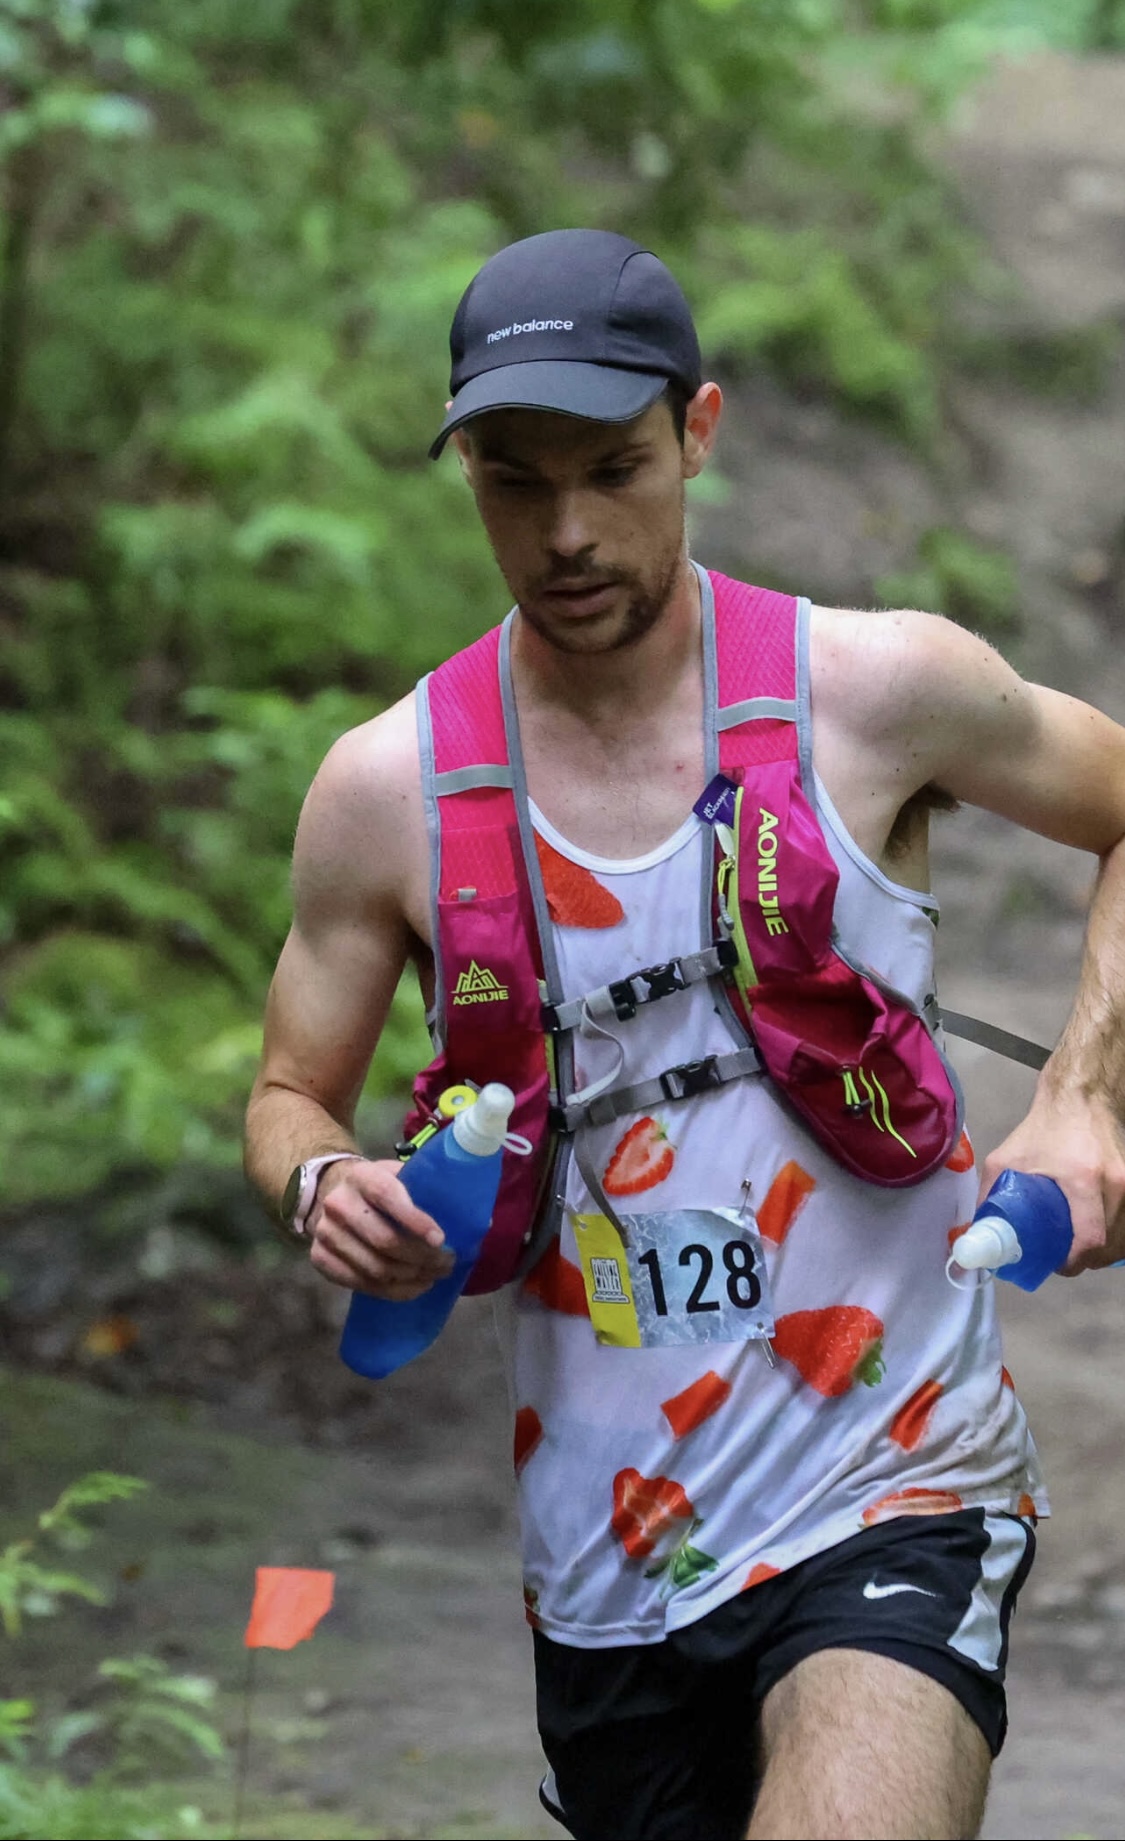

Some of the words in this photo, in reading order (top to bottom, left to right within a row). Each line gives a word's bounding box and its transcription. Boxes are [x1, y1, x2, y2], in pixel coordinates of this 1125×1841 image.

[487, 326, 511, 344] new
[513, 319, 574, 335] balance
[757, 807, 789, 937] AONIJIE
[453, 989, 509, 1006] AONIJIE
[638, 1240, 761, 1317] 128
